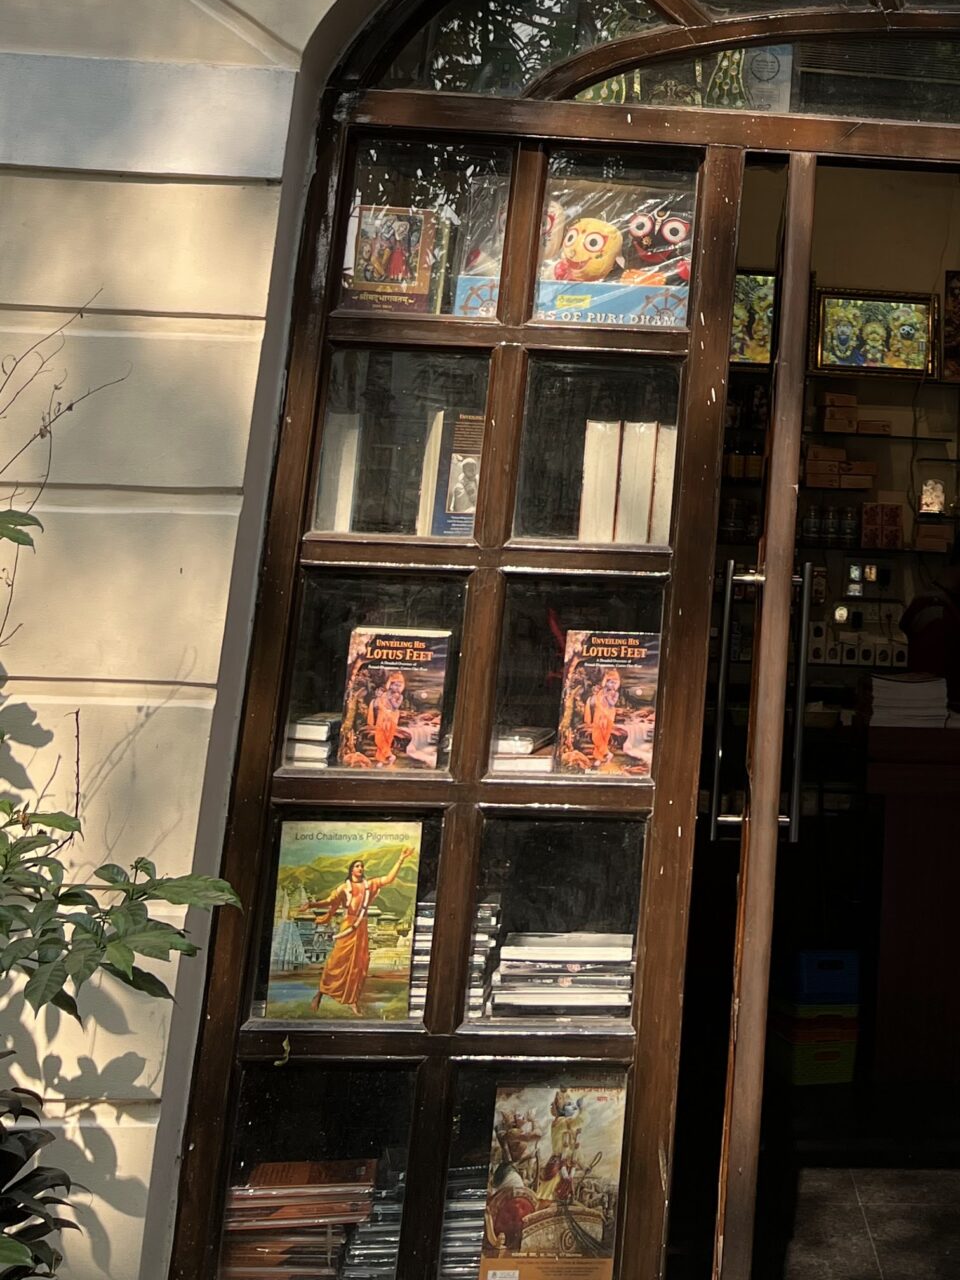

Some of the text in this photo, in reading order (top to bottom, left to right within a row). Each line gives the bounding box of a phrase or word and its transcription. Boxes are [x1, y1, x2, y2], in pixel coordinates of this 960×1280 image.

[561, 311, 582, 322] OF
[586, 312, 625, 324] PURI
[628, 314, 678, 326] DHAM
[366, 647, 434, 661] LOTUS FEET
[582, 645, 648, 658] LOTUS FEET
[295, 832, 410, 844] Lord Chaitanya's Pilgrimage
